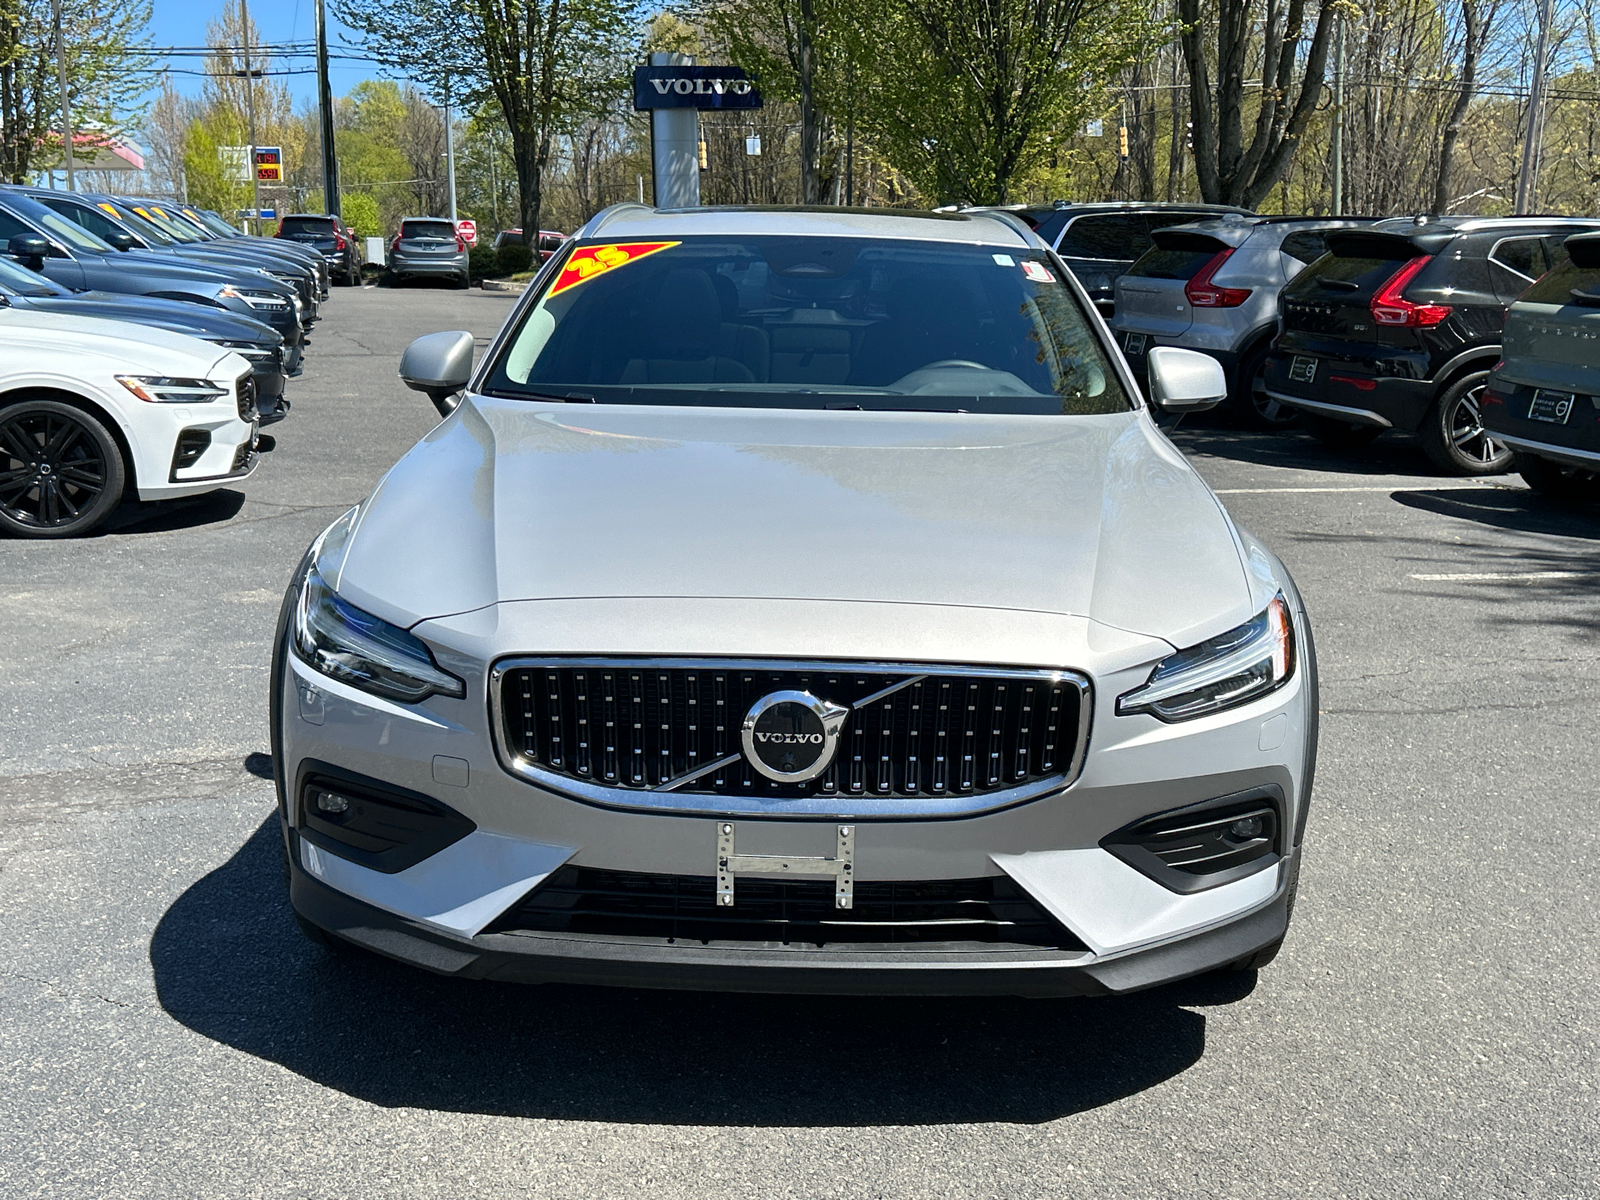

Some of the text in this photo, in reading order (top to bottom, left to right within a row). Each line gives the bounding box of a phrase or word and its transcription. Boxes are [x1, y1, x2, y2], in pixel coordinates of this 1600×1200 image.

[649, 79, 752, 94] VOLVO
[566, 246, 630, 278] 25
[755, 732, 823, 744] VOLVO
